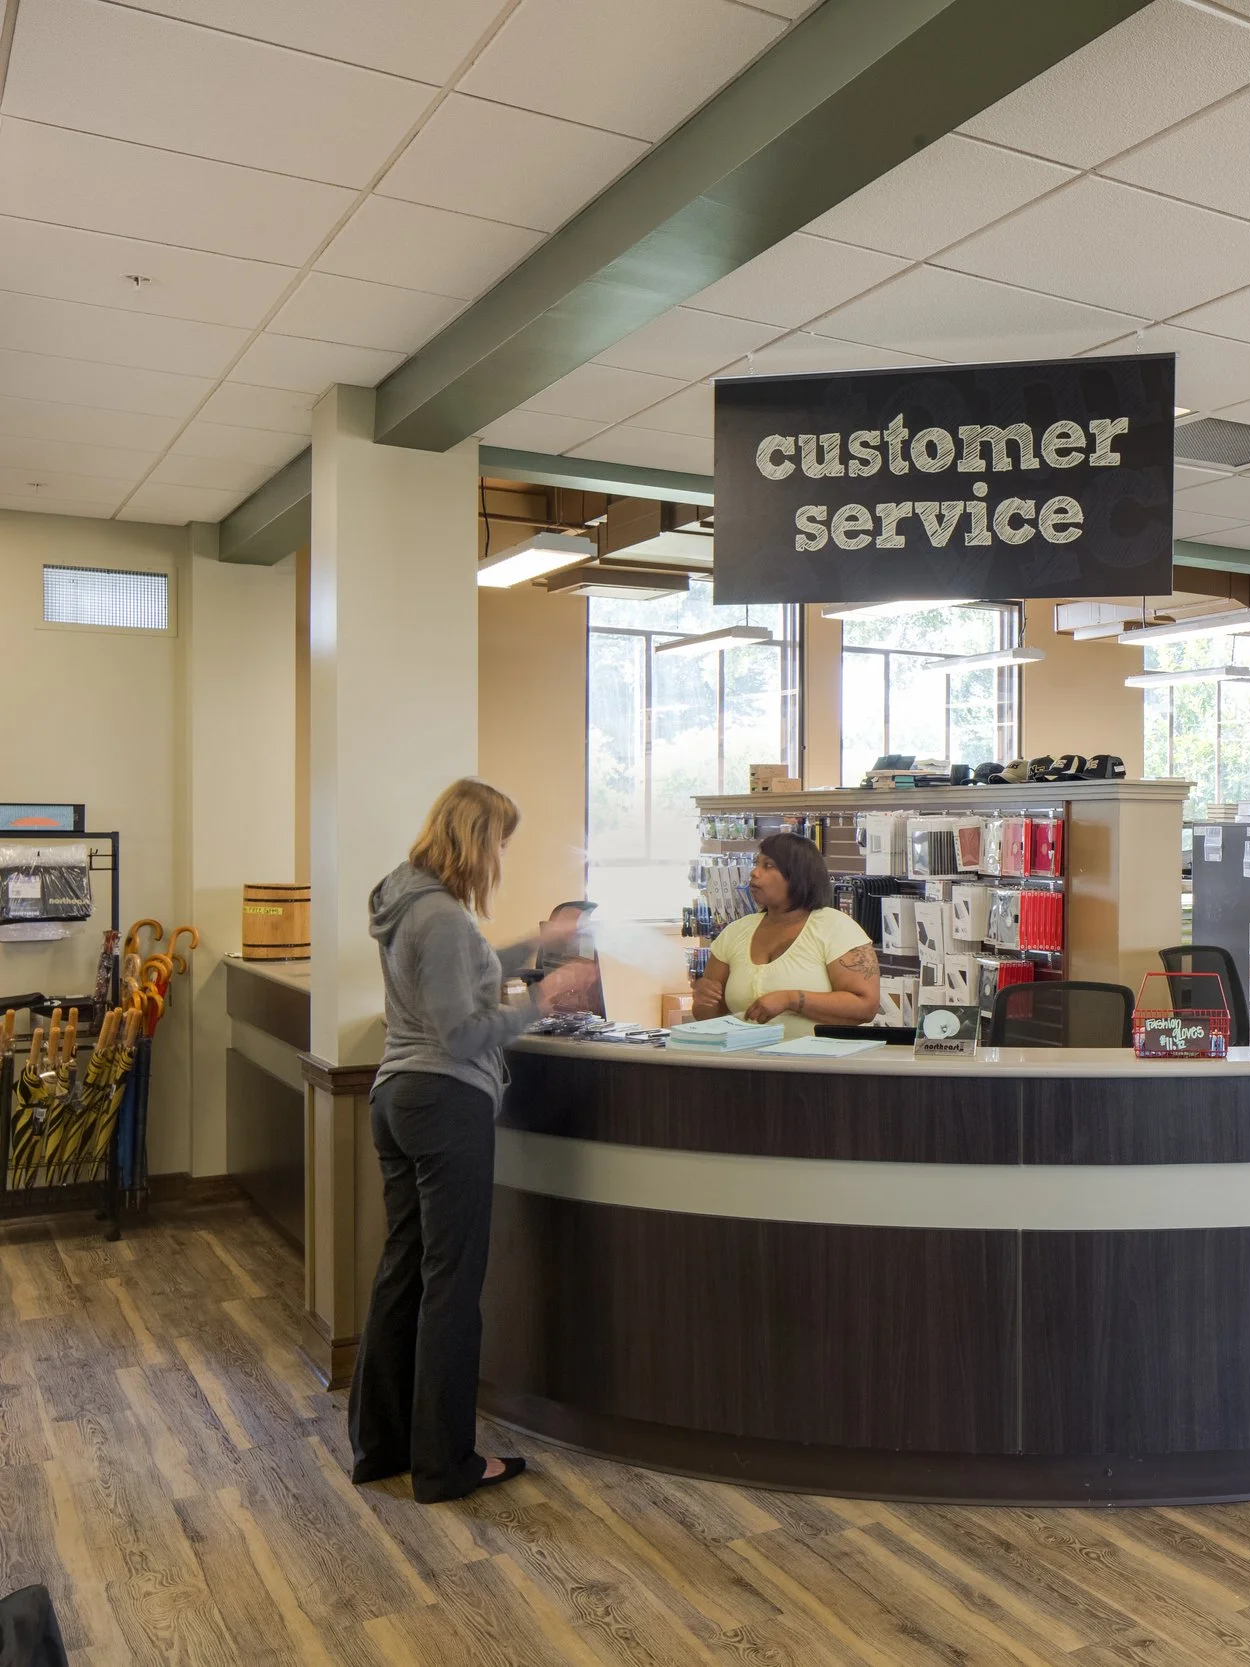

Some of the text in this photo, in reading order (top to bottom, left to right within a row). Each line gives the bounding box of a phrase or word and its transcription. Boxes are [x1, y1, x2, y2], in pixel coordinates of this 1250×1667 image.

[756, 413, 1129, 480] customer
[795, 481, 1084, 552] service
[1145, 1017, 1181, 1031] Fashion
[924, 1043, 959, 1051] northeast
